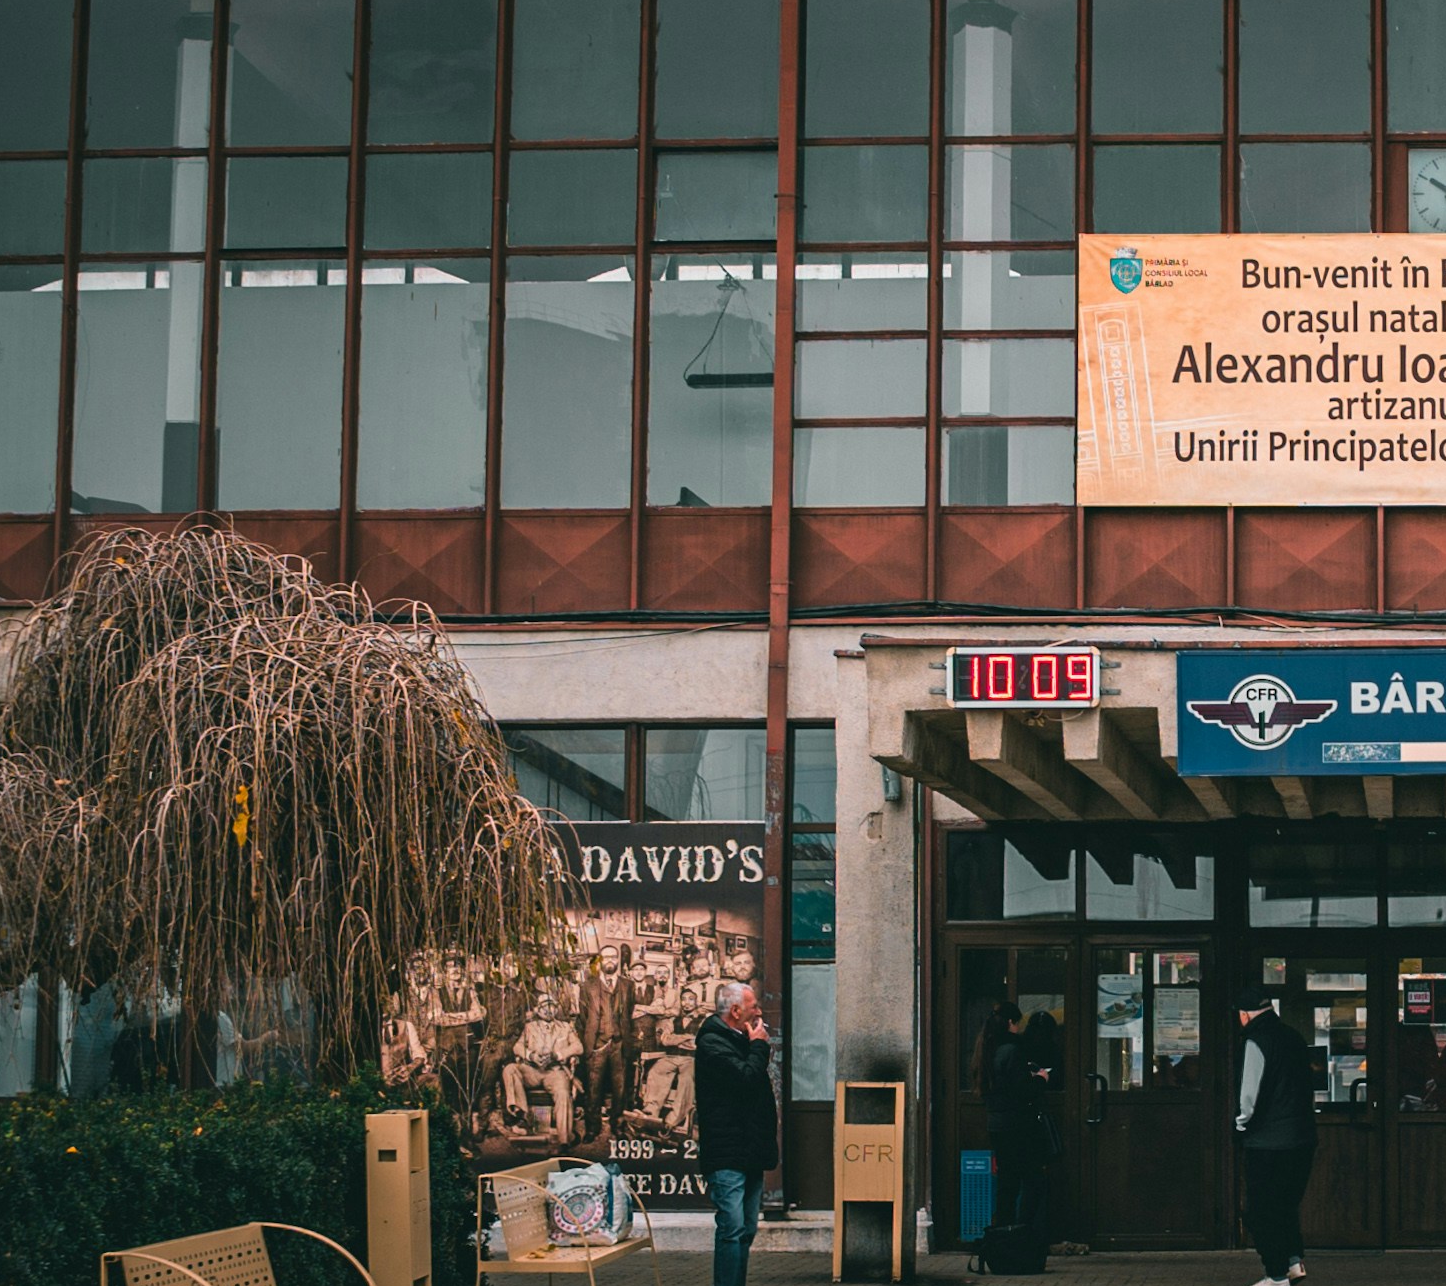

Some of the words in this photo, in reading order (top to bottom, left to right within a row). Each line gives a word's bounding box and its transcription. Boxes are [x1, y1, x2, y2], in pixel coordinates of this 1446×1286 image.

[1145, 269, 1183, 277] CONSILIUL
[1185, 269, 1208, 277] LOCAL
[1242, 256, 1392, 289] Bun-venit
[1400, 256, 1429, 288] în
[1262, 300, 1357, 343] orașul
[1370, 300, 1446, 333] natal
[1173, 344, 1384, 383] Alexandru
[1173, 430, 1258, 462] Unirii
[1247, 688, 1278, 701] CFR
[608, 1139, 654, 1159] 1999
[843, 1143, 895, 1163] CFR
